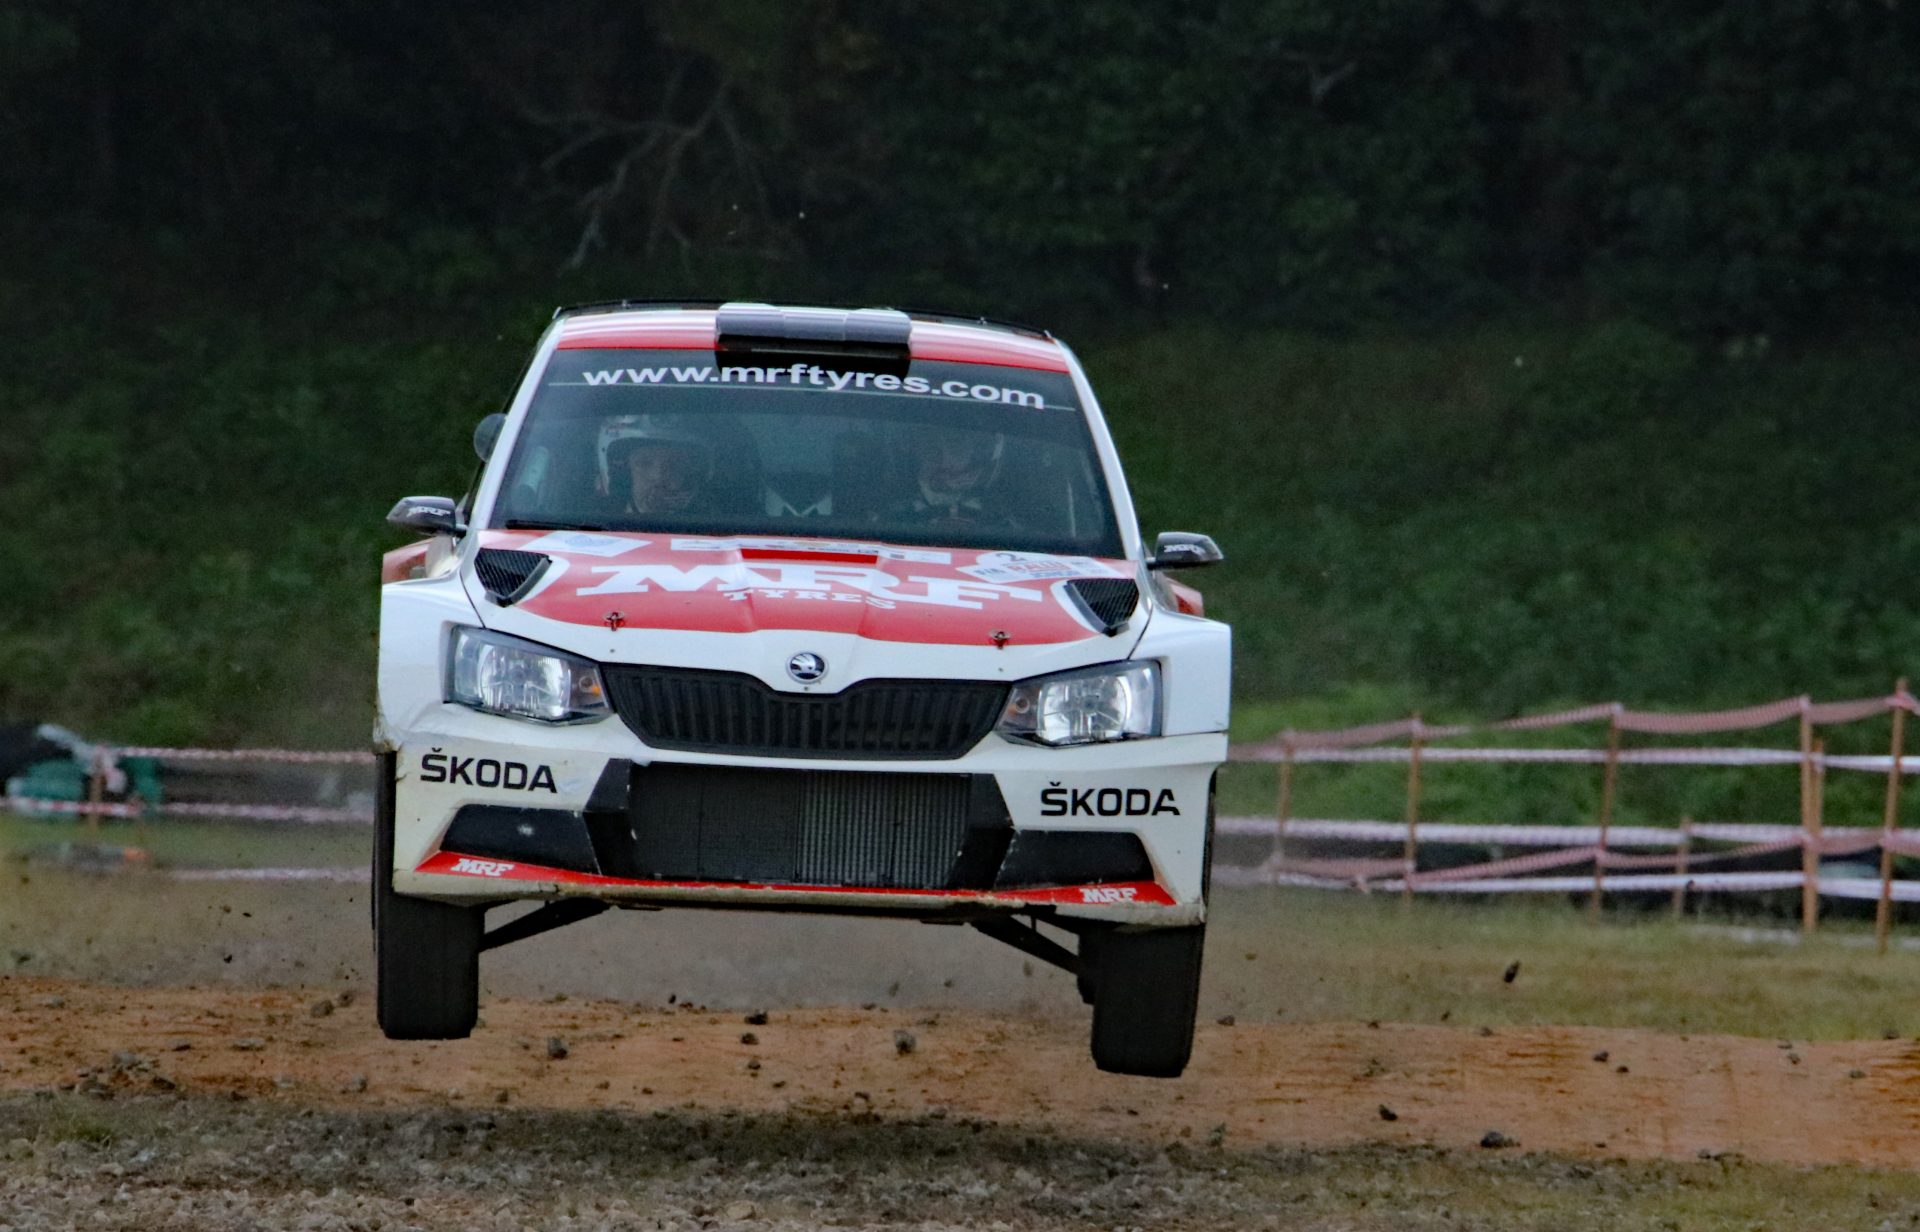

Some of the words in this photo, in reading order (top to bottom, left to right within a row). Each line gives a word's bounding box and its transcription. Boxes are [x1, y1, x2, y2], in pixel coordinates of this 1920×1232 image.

[582, 363, 1045, 409] www.mrftyres.com
[576, 562, 1042, 609] MRF
[724, 588, 896, 609] TYRES
[420, 748, 557, 793] ŠKODA
[1040, 782, 1180, 816] ŠKODA
[451, 858, 514, 876] MRF
[1080, 887, 1138, 904] MRF
